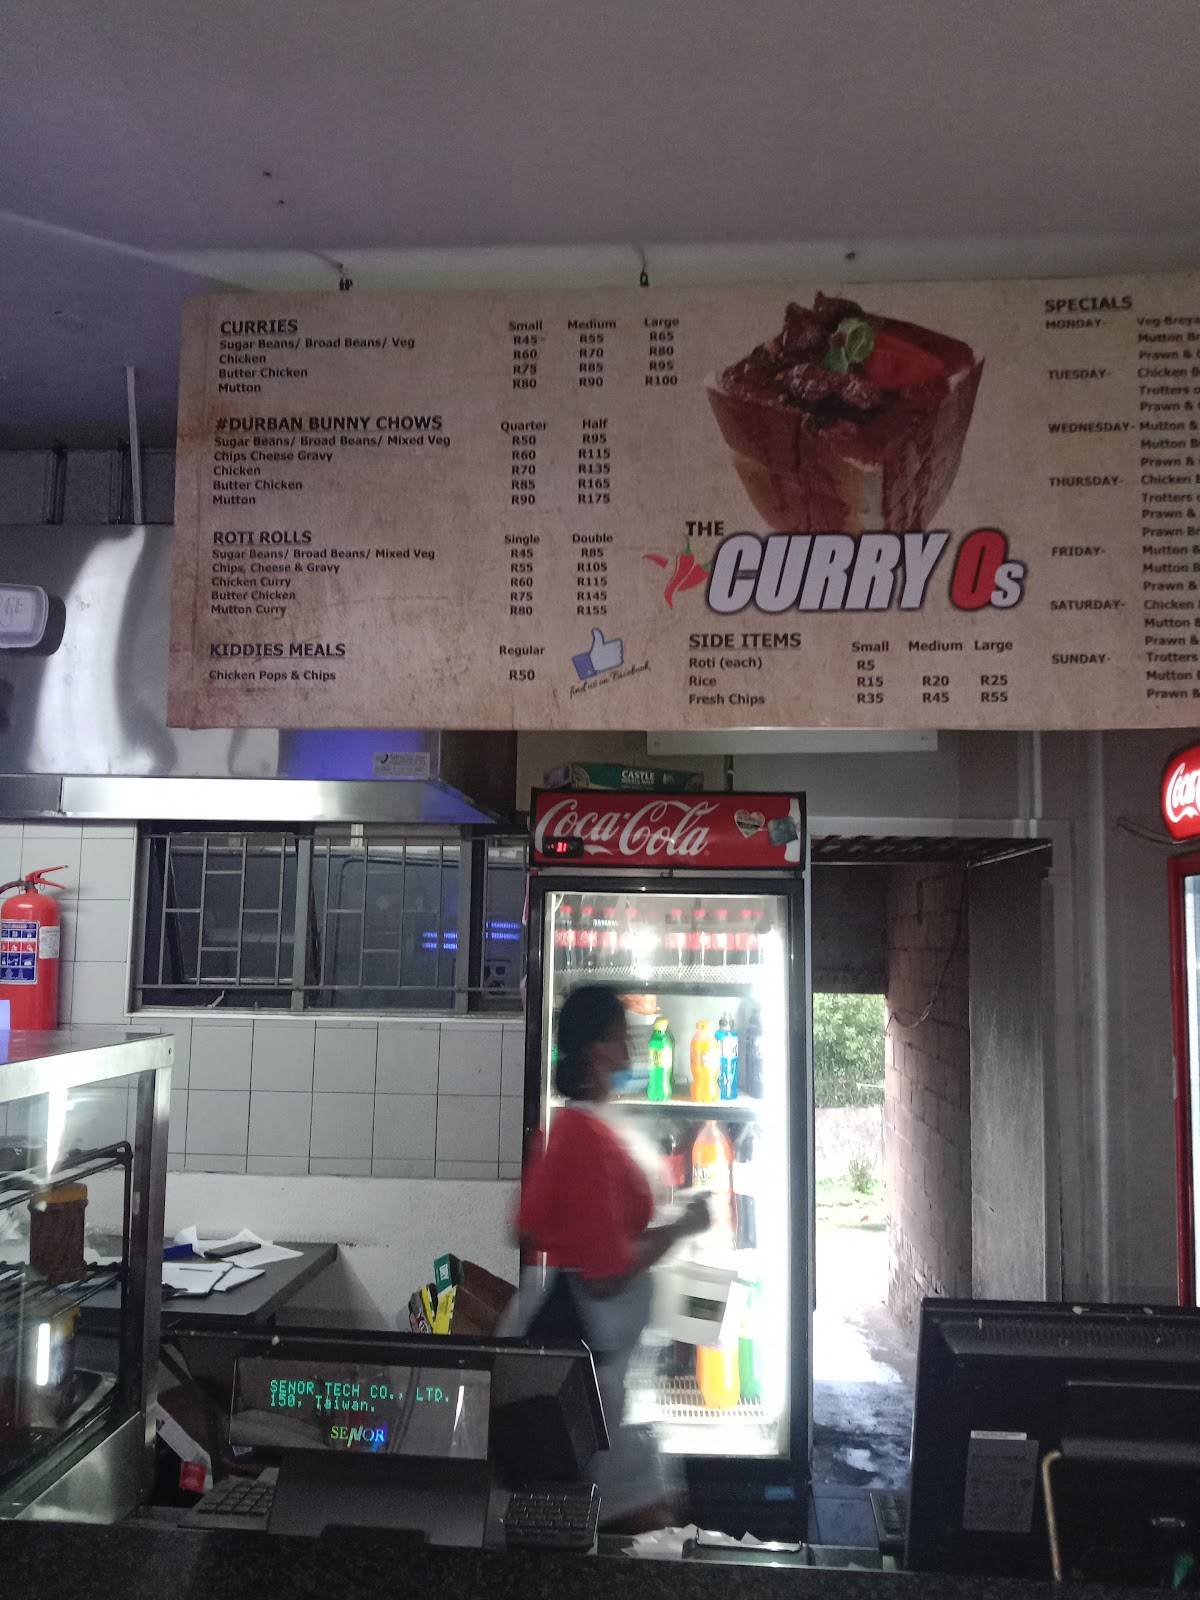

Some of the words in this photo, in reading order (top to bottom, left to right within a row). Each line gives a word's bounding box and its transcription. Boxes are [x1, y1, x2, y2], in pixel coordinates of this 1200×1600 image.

[1045, 296, 1133, 313] SPECIALS
[220, 320, 298, 333] CURRIES
[509, 321, 542, 331] Small
[568, 319, 616, 330] Medium
[644, 318, 679, 329] Large
[513, 335, 537, 345] R45
[650, 332, 674, 342] R65
[1138, 334, 1182, 342] Mutton
[220, 339, 255, 350] Sugar
[258, 338, 299, 350] Beans/
[305, 338, 340, 348] Broad
[344, 338, 386, 348] Beans/
[392, 338, 414, 349] Veg
[513, 350, 537, 359] R60
[579, 348, 603, 358] R70
[650, 347, 674, 356] R80
[1139, 351, 1178, 360] Prawn
[219, 354, 266, 364] Chicken
[219, 368, 256, 378] Butter
[260, 368, 308, 378] Chicken
[513, 364, 536, 374] R75
[649, 361, 674, 371] R95
[1138, 368, 1187, 378] Chicken
[579, 378, 603, 387] R90
[645, 376, 677, 386] R100
[218, 383, 261, 393] Mutton
[1139, 386, 1189, 396] Trotters
[1140, 402, 1180, 411] Prawn
[216, 417, 302, 431] #DURBAN
[309, 416, 370, 430] BUNNY
[376, 416, 442, 430] CHOWS
[501, 421, 548, 435] Quarter
[582, 419, 608, 429] Half
[1139, 421, 1184, 431] Mutton
[214, 437, 250, 448] Sugar
[254, 436, 295, 447] Beans/
[300, 436, 336, 446] Broad
[340, 436, 382, 446] Beans/
[388, 436, 424, 446] Mixed
[428, 436, 450, 446] Veg
[512, 436, 536, 445] R50
[582, 434, 606, 444] R95
[1141, 439, 1186, 448] Mutton
[214, 451, 246, 462] Chips
[251, 451, 294, 461] Cheese
[298, 451, 332, 462] Gravy
[512, 450, 536, 460] R60
[579, 449, 610, 459] R115
[1141, 457, 1181, 467] Prawn
[214, 466, 260, 476] Chicken
[512, 465, 536, 475] R70
[578, 464, 610, 474] R135
[213, 480, 251, 490] Butter
[255, 480, 302, 490] Chicken
[512, 480, 535, 490] R85
[578, 479, 610, 489] R165
[1141, 475, 1191, 485] Chicken
[212, 495, 256, 504] Mutton
[512, 495, 535, 505] R90
[578, 494, 610, 504] R175
[1142, 493, 1192, 503] Trotters
[1142, 509, 1182, 519] Prawn
[686, 521, 724, 536] THE
[1142, 527, 1183, 537] Prawn
[214, 532, 254, 544] ROTI
[260, 531, 312, 544] ROLLS
[505, 534, 540, 545] Single
[572, 533, 613, 543] Double
[212, 549, 246, 560] Sugar
[250, 549, 289, 560] Beans/
[294, 549, 326, 558] Broad
[331, 548, 370, 559] Beans/
[376, 549, 410, 559] Mixed
[414, 549, 435, 560] Veg
[511, 549, 533, 558] R45
[581, 548, 604, 558] R85
[1052, 546, 1105, 556] FRIDAY-
[1143, 545, 1188, 555] Mutton
[250, 562, 291, 572] Cheese
[295, 563, 302, 572] &
[307, 562, 340, 574] Gravy
[511, 563, 533, 573] R55
[577, 563, 607, 572] R105
[708, 531, 949, 614] CURRY
[1143, 564, 1189, 573] Mutton
[212, 577, 256, 587] Chicken
[260, 577, 291, 588] Curry
[511, 577, 533, 587] R60
[577, 577, 607, 586] R115
[1144, 581, 1184, 591] Prawn
[211, 591, 248, 600] Butter
[252, 590, 296, 600] Chicken
[510, 592, 532, 601] R75
[577, 592, 607, 601] R145
[211, 605, 252, 614] Mutton
[256, 604, 286, 616] Curry
[1051, 600, 1126, 610] SATURDAY-
[1144, 600, 1194, 609] Chicken
[510, 606, 532, 616] R80
[577, 606, 607, 615] R155
[1145, 618, 1190, 628] Mutton
[689, 634, 734, 648] SIDE
[741, 634, 801, 648] ITEMS
[852, 640, 889, 653] Small
[908, 639, 963, 651] Medium
[974, 639, 1013, 652] Large
[1145, 636, 1185, 646] Prawn
[210, 644, 284, 657] KIDDIES
[289, 644, 346, 656] MEALS
[499, 645, 545, 657] Regular
[689, 657, 715, 669] Roti
[720, 656, 763, 670] (each)
[1052, 654, 1111, 664] SUNDAY-
[1146, 652, 1198, 662] Trotters
[857, 659, 875, 670] R5
[209, 670, 255, 680] Chicken
[259, 670, 287, 682] Pops
[291, 671, 299, 680] &
[303, 670, 336, 682] Chips
[509, 670, 535, 681] R50
[689, 675, 716, 687] Rice
[857, 676, 883, 687] R15
[923, 675, 949, 686] R20
[980, 675, 1008, 686] R25
[1146, 671, 1192, 680] Mutton
[857, 692, 883, 703] R35
[923, 692, 949, 703] R45
[981, 691, 1008, 703] R55
[1147, 689, 1188, 698] Prawn
[689, 693, 724, 705] Fresh
[729, 693, 765, 707] Chips
[621, 769, 655, 780] CASTLE
[535, 798, 720, 857] Coca-Cola
[270, 1380, 314, 1395] SENOR
[325, 1382, 360, 1398] TECH
[416, 1387, 449, 1402] LTD.
[315, 1395, 375, 1412] Taiwan.
[331, 1425, 385, 1447] SENOR
